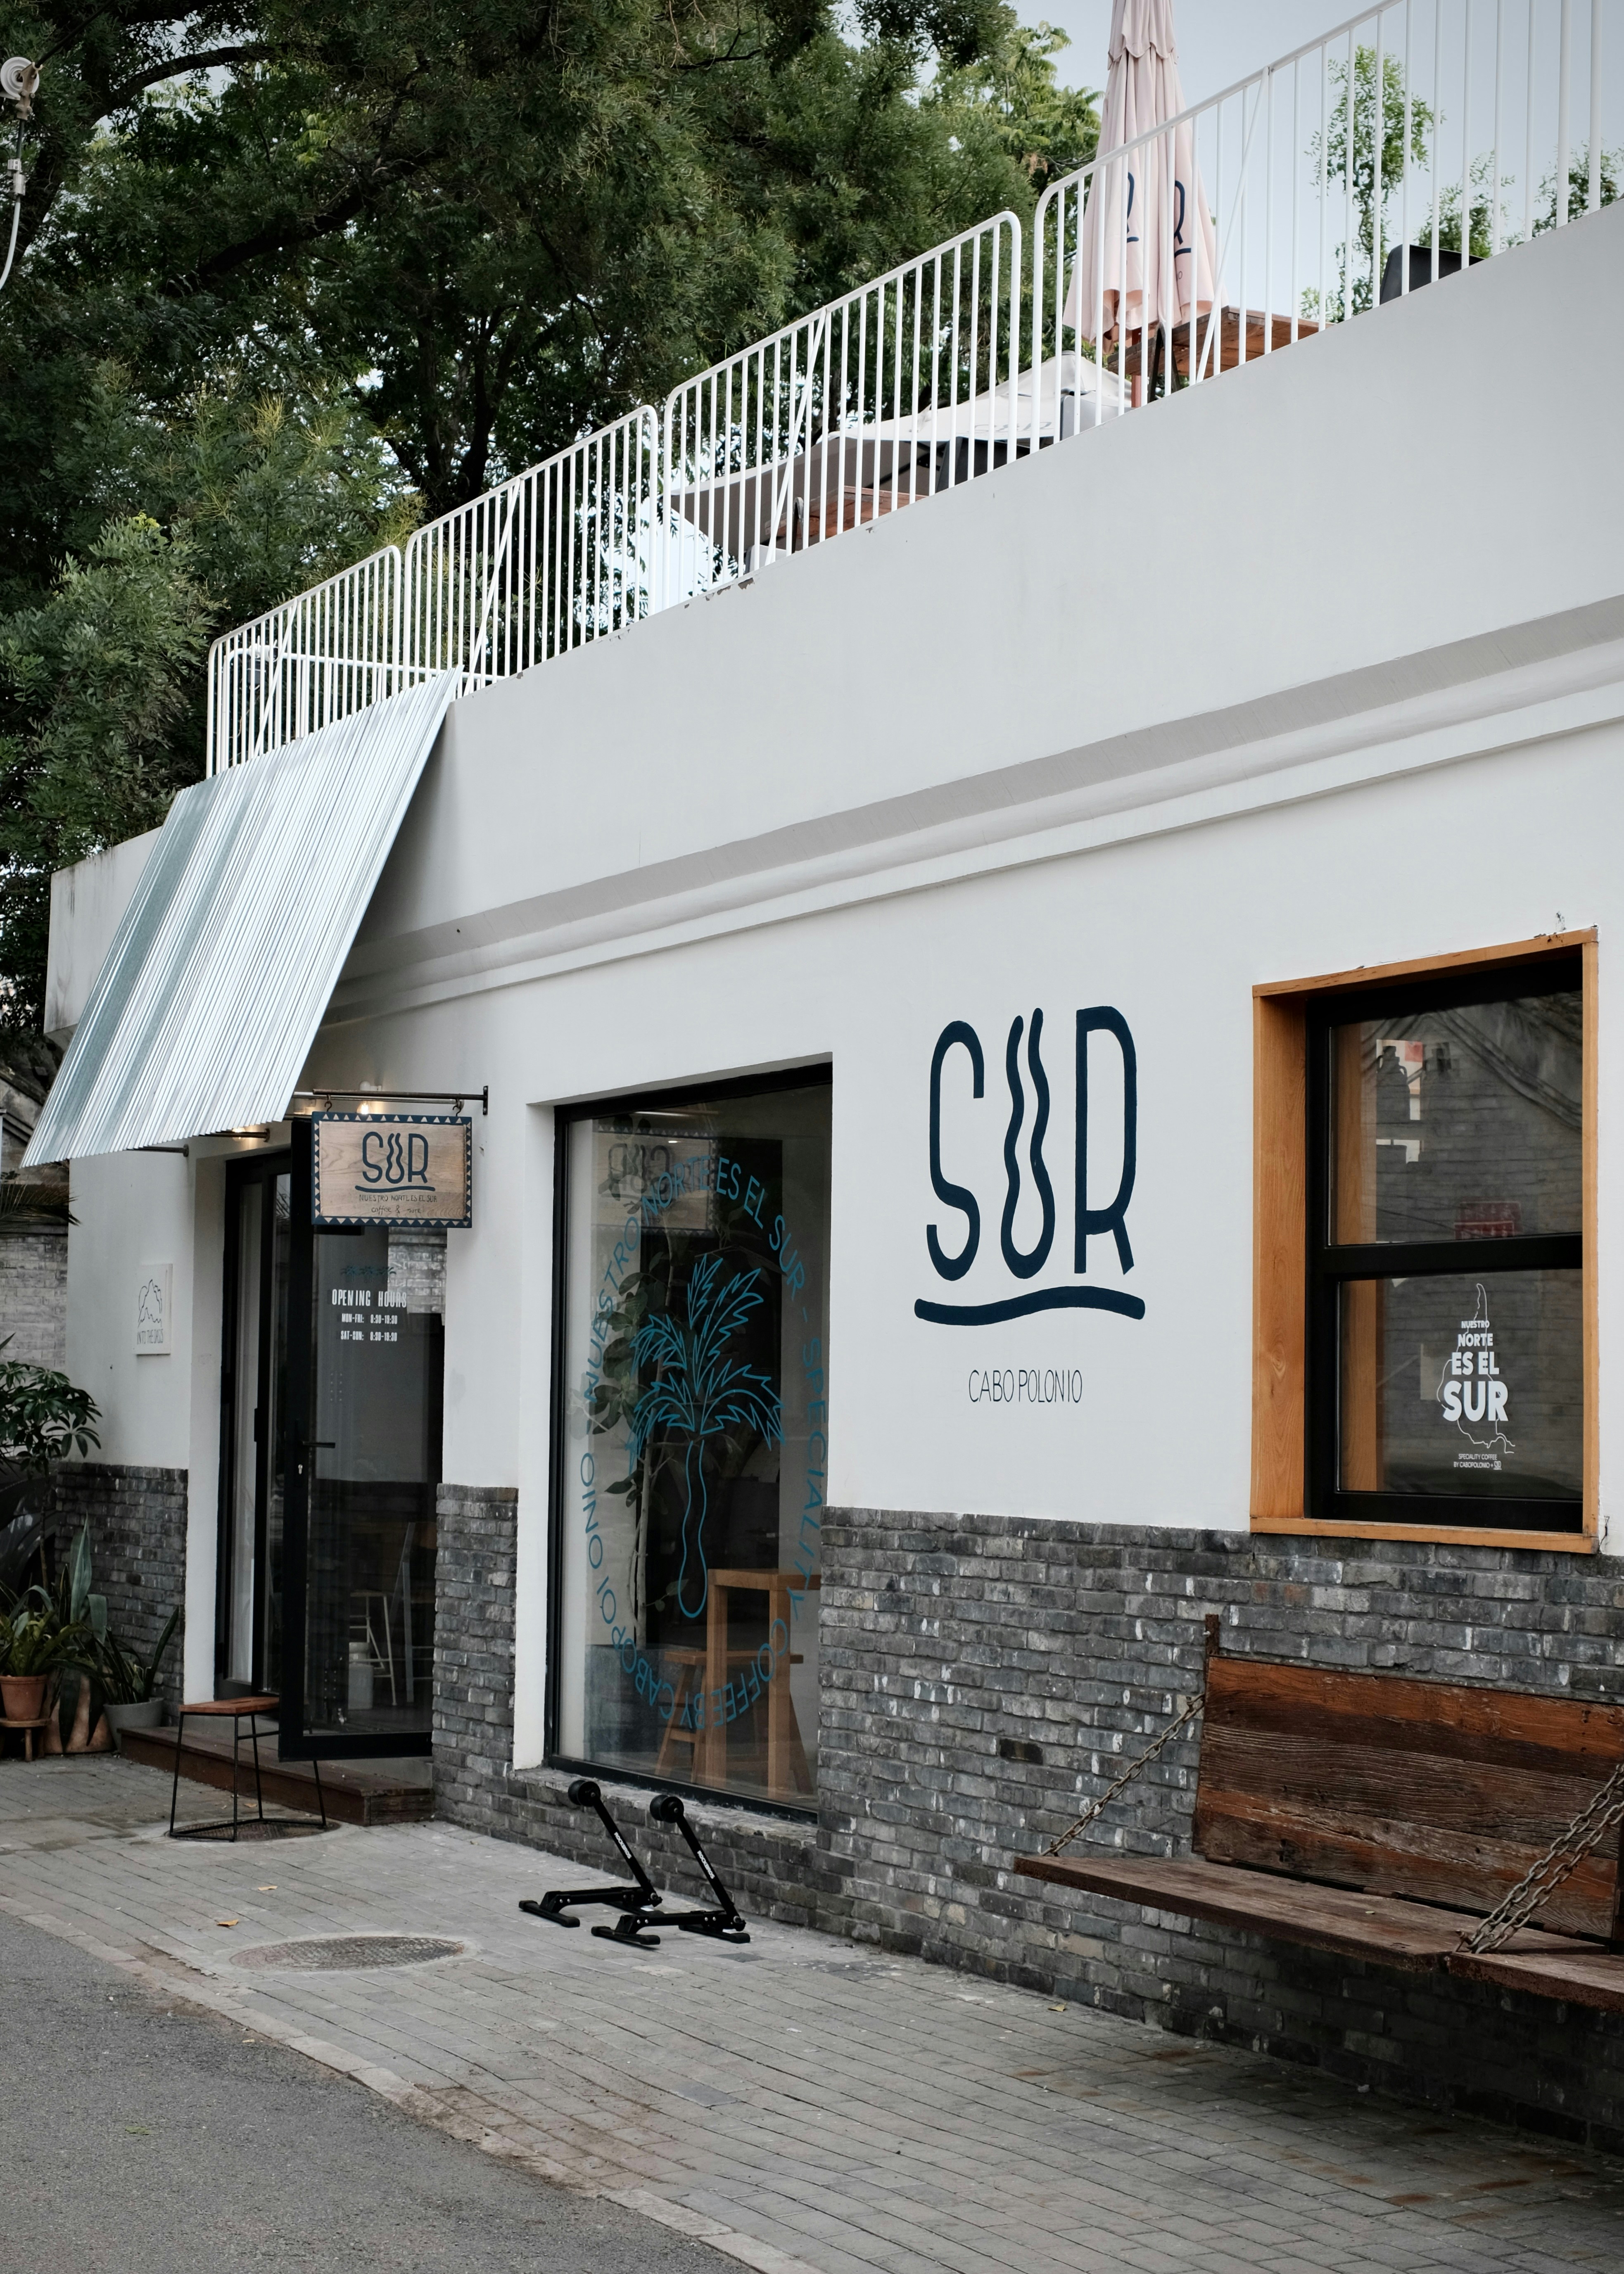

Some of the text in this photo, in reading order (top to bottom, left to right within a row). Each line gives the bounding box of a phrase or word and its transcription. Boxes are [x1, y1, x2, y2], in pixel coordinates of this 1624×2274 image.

[363, 1131, 428, 1184] SUR
[926, 1006, 1137, 1281] SUR
[641, 1155, 711, 1227] NORTE
[716, 1156, 741, 1200] ES
[359, 1194, 389, 1203] NUESTRO
[371, 1205, 392, 1215] coffee
[744, 1175, 765, 1230] EL
[769, 1215, 805, 1302] SUR
[332, 1289, 407, 1308] OPENING HOURS
[584, 1216, 640, 1403] NUESTRO
[340, 1330, 364, 1341] SAT-SUN:
[341, 1313, 364, 1323] MON-FRI:
[1461, 1320, 1490, 1329] NUESTRO
[1458, 1333, 1493, 1347] NORTE
[1451, 1351, 1500, 1375] ES EL
[1443, 1380, 1508, 1422] SUR
[786, 1336, 826, 1622] SPECIALITY
[711, 1618, 788, 1727] COFFEE
[679, 1691, 705, 1729] BY
[614, 1832, 632, 1859] ROCKBROS
[697, 1850, 715, 1879] ROCKBROS
